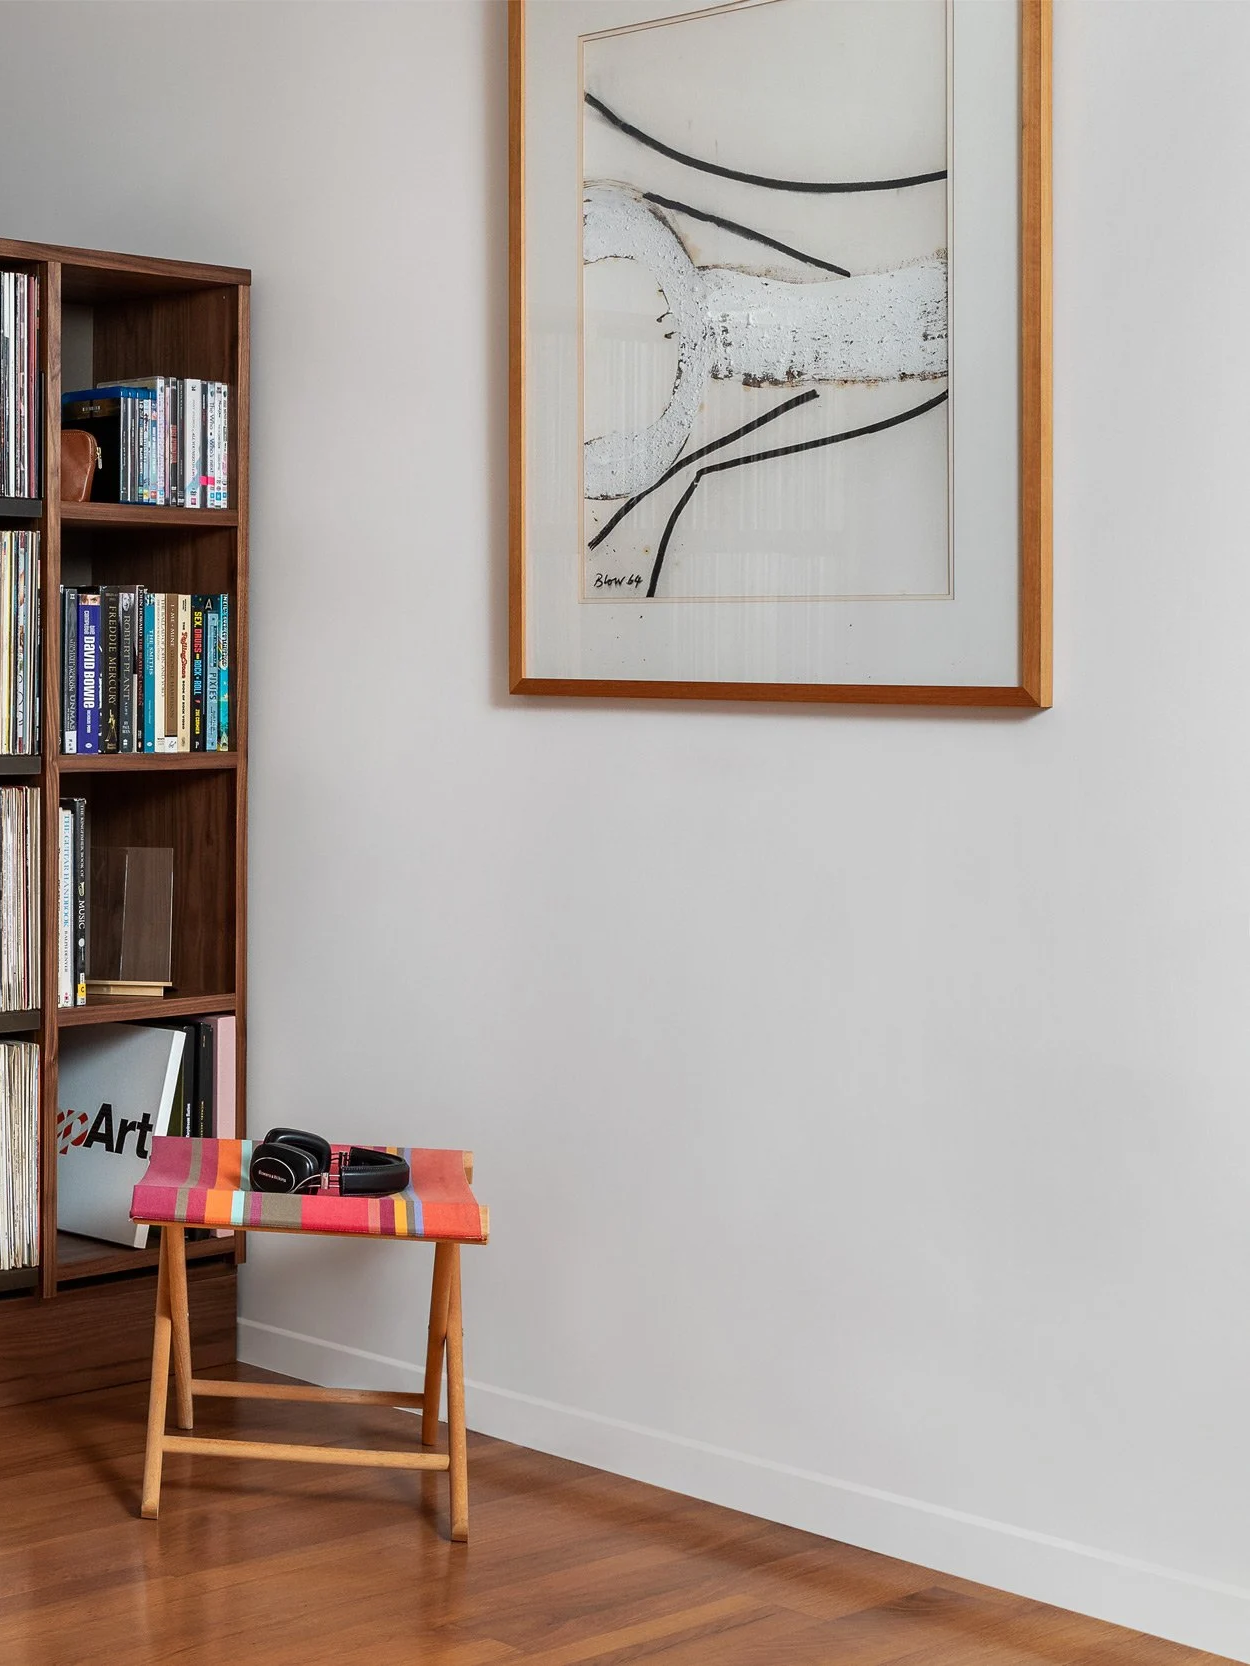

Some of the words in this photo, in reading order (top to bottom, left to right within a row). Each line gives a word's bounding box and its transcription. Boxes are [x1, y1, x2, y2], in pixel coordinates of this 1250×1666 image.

[594, 573, 625, 588] Blow
[626, 574, 643, 588] 64
[108, 605, 117, 652] FREDDIE
[171, 612, 175, 622] ME
[194, 611, 202, 627] SEX,
[123, 615, 131, 660] ROBERT
[194, 628, 202, 653] DRUGS
[194, 659, 202, 676] ROCK
[108, 657, 117, 705] MERCURY
[194, 680, 202, 695] ROLL
[209, 672, 217, 700] PIXIES
[57, 1103, 153, 1159] pArt
